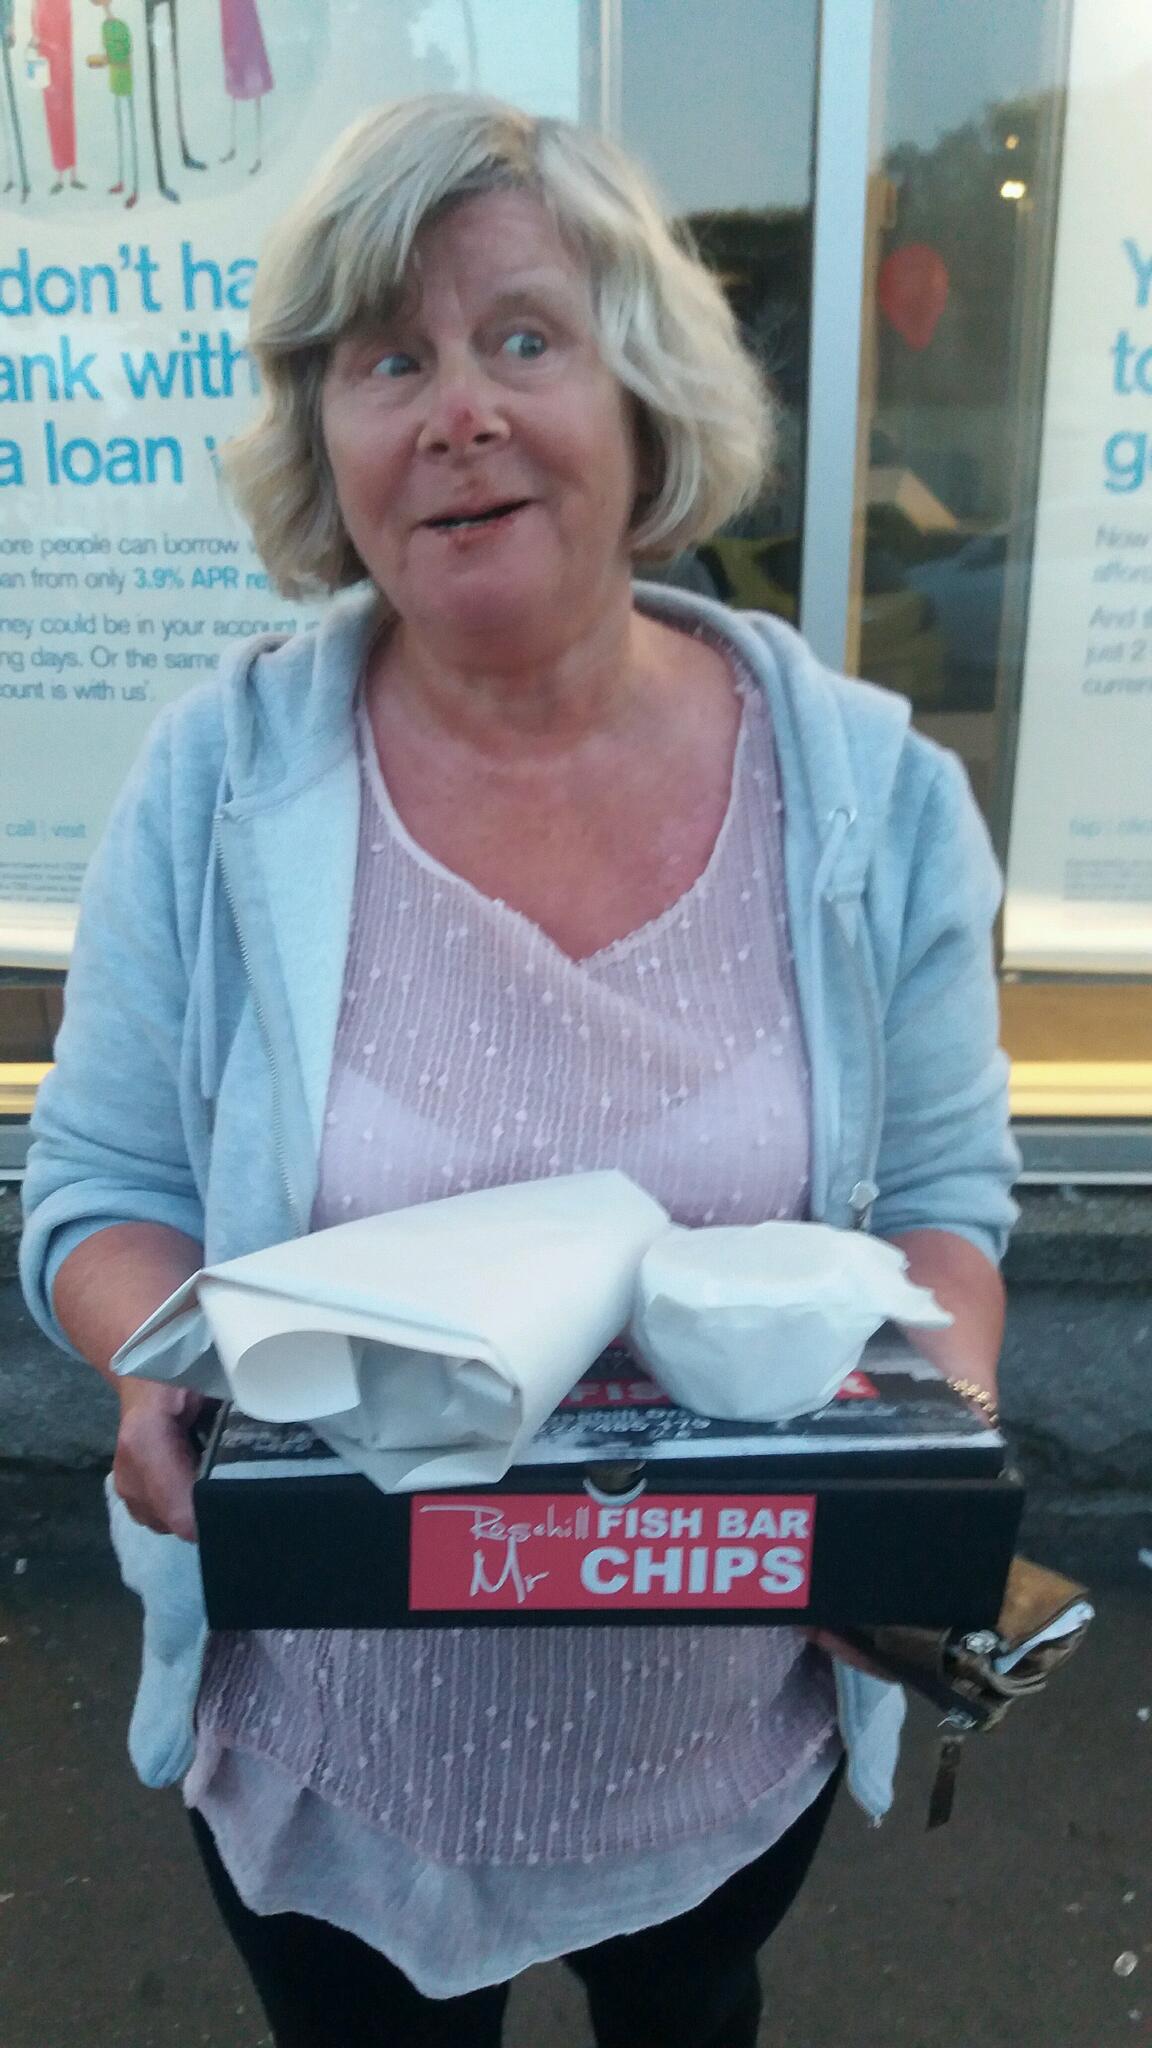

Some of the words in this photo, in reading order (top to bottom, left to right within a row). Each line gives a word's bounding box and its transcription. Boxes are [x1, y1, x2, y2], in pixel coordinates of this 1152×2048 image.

[0, 243, 162, 316] don't
[0, 440, 24, 486] a
[44, 419, 183, 486] loan
[1104, 431, 1152, 493] g
[41, 532, 111, 560] people
[117, 537, 157, 555] can
[163, 532, 239, 555] borrow
[31, 566, 78, 589] from
[84, 566, 125, 596] only
[134, 566, 185, 589] 3.9%
[191, 565, 239, 589] APR
[40, 613, 97, 635] could
[103, 612, 131, 635] be
[136, 613, 155, 635] in
[161, 618, 206, 642] your
[213, 617, 297, 636] account
[30, 645, 84, 673] days.
[90, 644, 118, 668] Or
[125, 648, 158, 669] the
[164, 653, 220, 670] same
[51, 682, 68, 700] is
[73, 679, 115, 700] with
[597, 1508, 702, 1539] FISH
[717, 1508, 809, 1539] BAR
[469, 1537, 550, 1604] Mr
[580, 1547, 806, 1594] CHIPS
